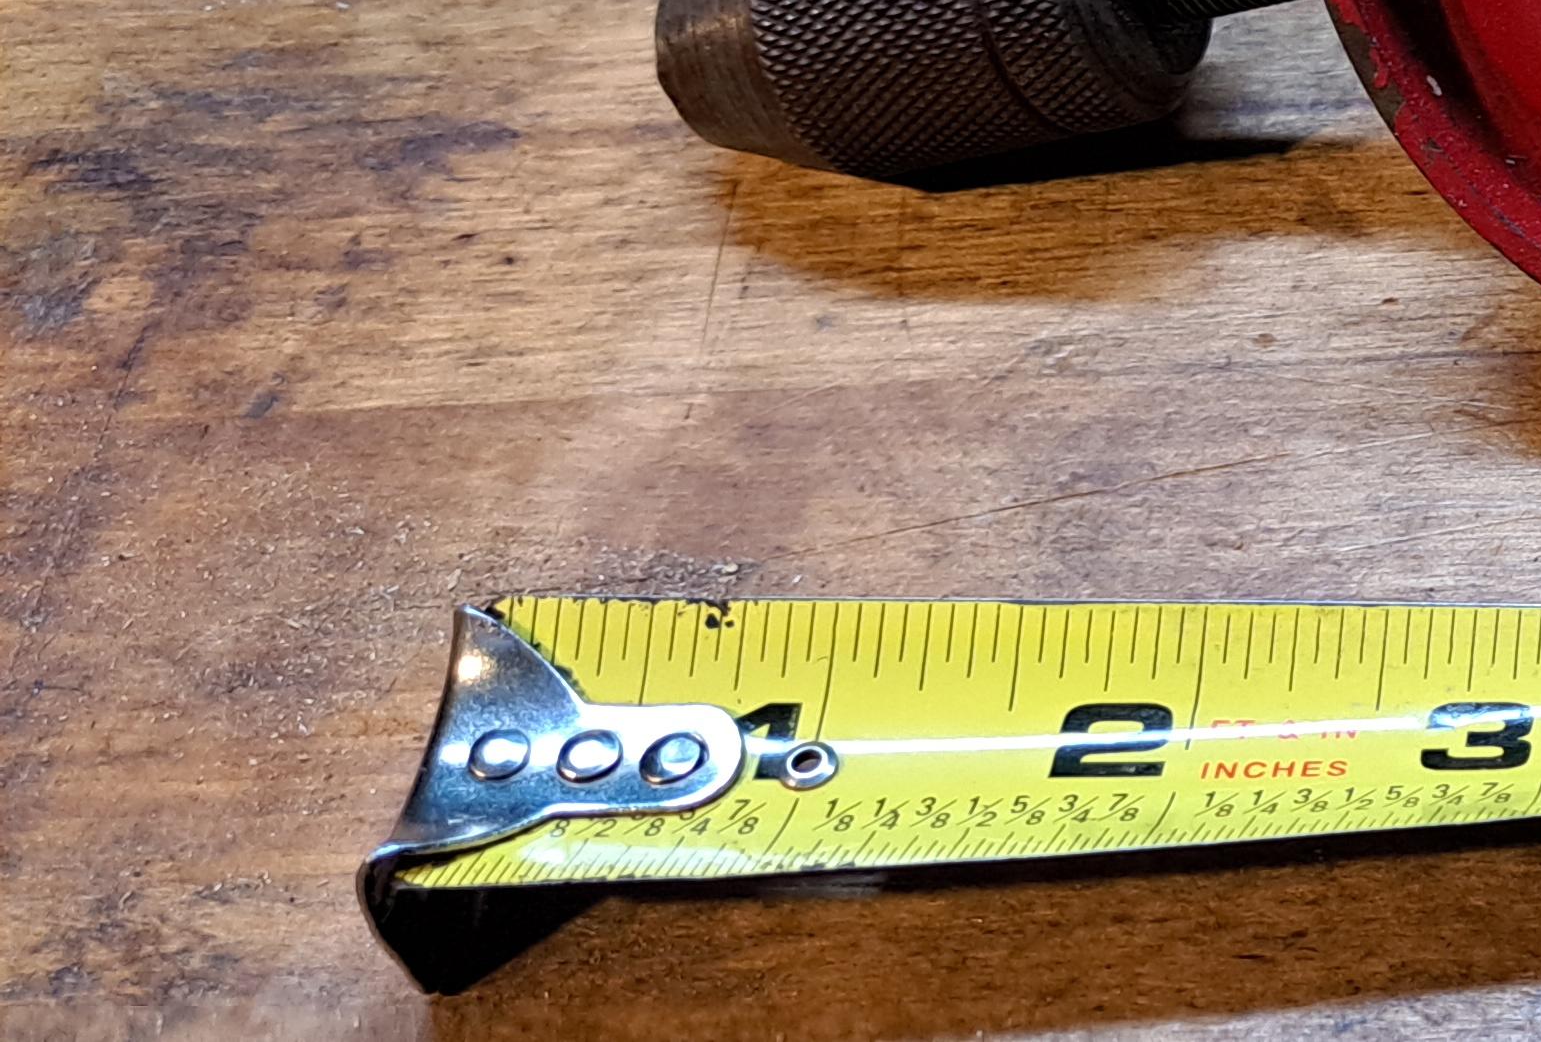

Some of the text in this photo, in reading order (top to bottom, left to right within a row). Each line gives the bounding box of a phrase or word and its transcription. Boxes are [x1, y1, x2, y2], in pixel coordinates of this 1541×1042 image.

[1048, 702, 1174, 778] 2
[1421, 702, 1534, 770] 3
[1200, 760, 1348, 780] INCHES
[575, 818, 617, 837] /2
[624, 813, 665, 837] /8
[717, 799, 766, 835] 7/8
[813, 798, 863, 831] 1/8
[861, 797, 911, 830] 1/4
[911, 796, 957, 828] 3/8
[956, 796, 1004, 827] 1/2
[1004, 795, 1052, 825] 5/8
[1053, 794, 1099, 823] 3/4
[1099, 793, 1144, 821] 7/8
[1195, 792, 1239, 817] 1/8
[1243, 790, 1287, 815] 1/4
[1290, 789, 1333, 813] 3/8
[1336, 787, 1378, 811] 1/2
[1382, 786, 1424, 808] 5/8
[1430, 784, 1471, 805] 3/4
[1475, 782, 1515, 804] 7/8
